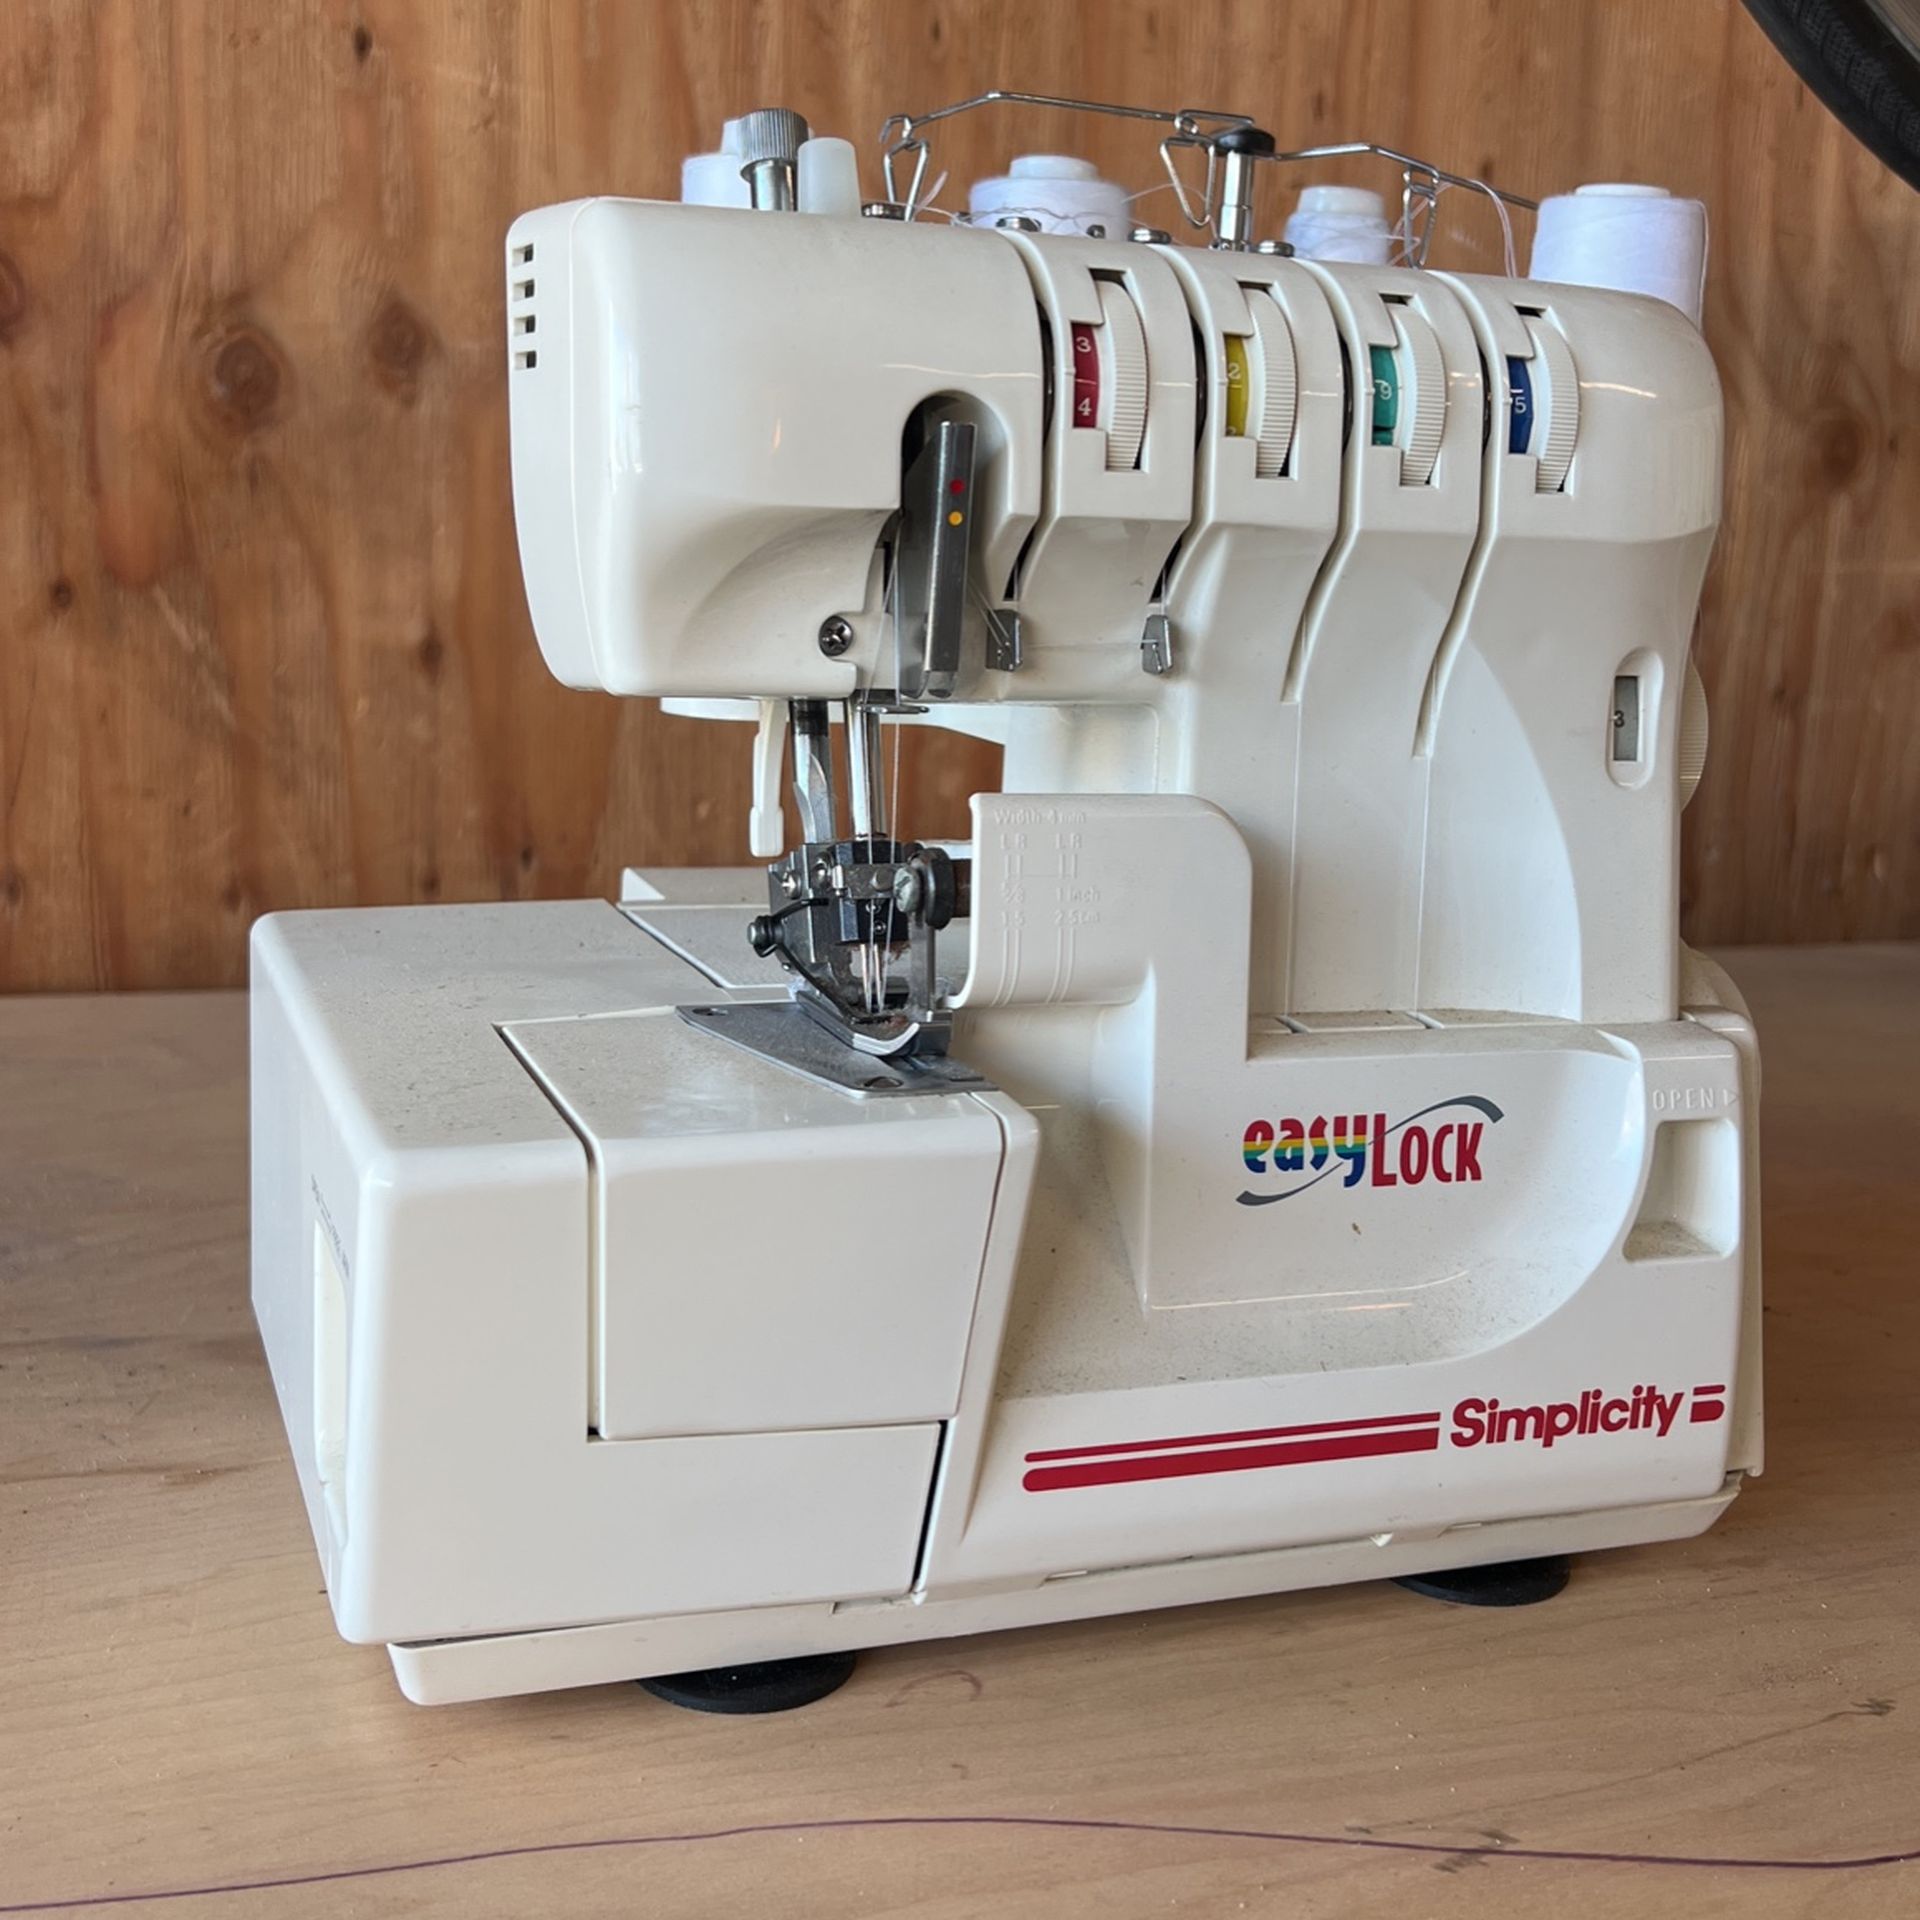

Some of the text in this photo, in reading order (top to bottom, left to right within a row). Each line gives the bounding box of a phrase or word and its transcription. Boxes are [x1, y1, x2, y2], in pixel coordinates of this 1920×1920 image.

[1076, 336, 1091, 353] 3
[1228, 362, 1242, 380] 2
[1077, 397, 1092, 416] 4
[1514, 396, 1527, 414] 5
[1614, 710, 1625, 728] 3
[1652, 1087, 1715, 1111] OPEN
[1450, 1385, 1685, 1448] Simplicity
